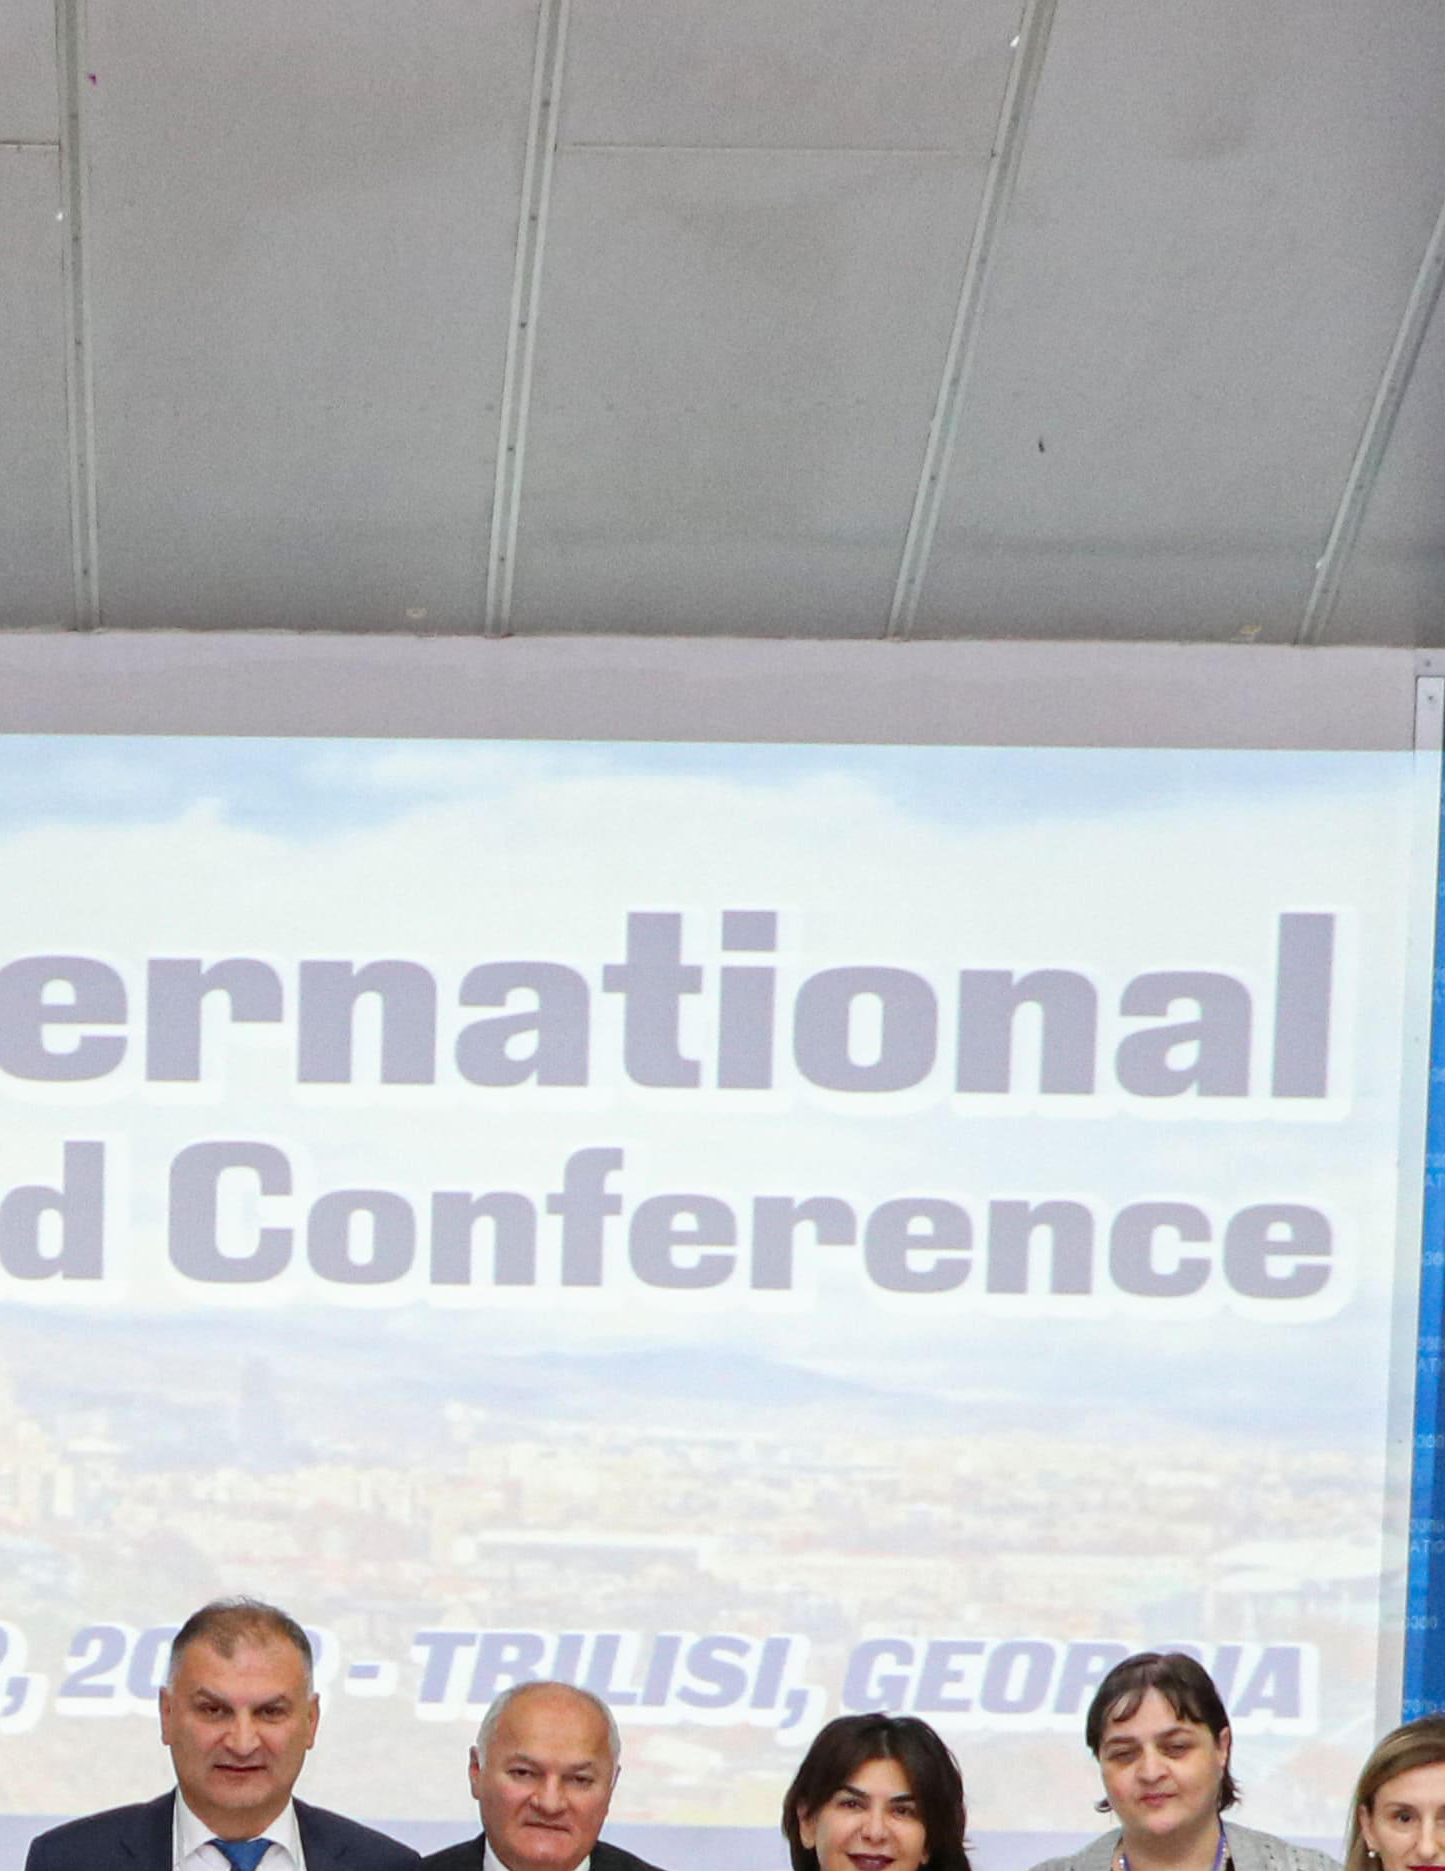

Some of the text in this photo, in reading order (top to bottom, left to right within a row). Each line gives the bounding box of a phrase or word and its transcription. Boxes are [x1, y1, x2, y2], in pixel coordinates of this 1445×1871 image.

[166, 1139, 1335, 1300] Conference
[412, 1631, 809, 1729] TBILISI,
[842, 1638, 1303, 1718] GEORIA
